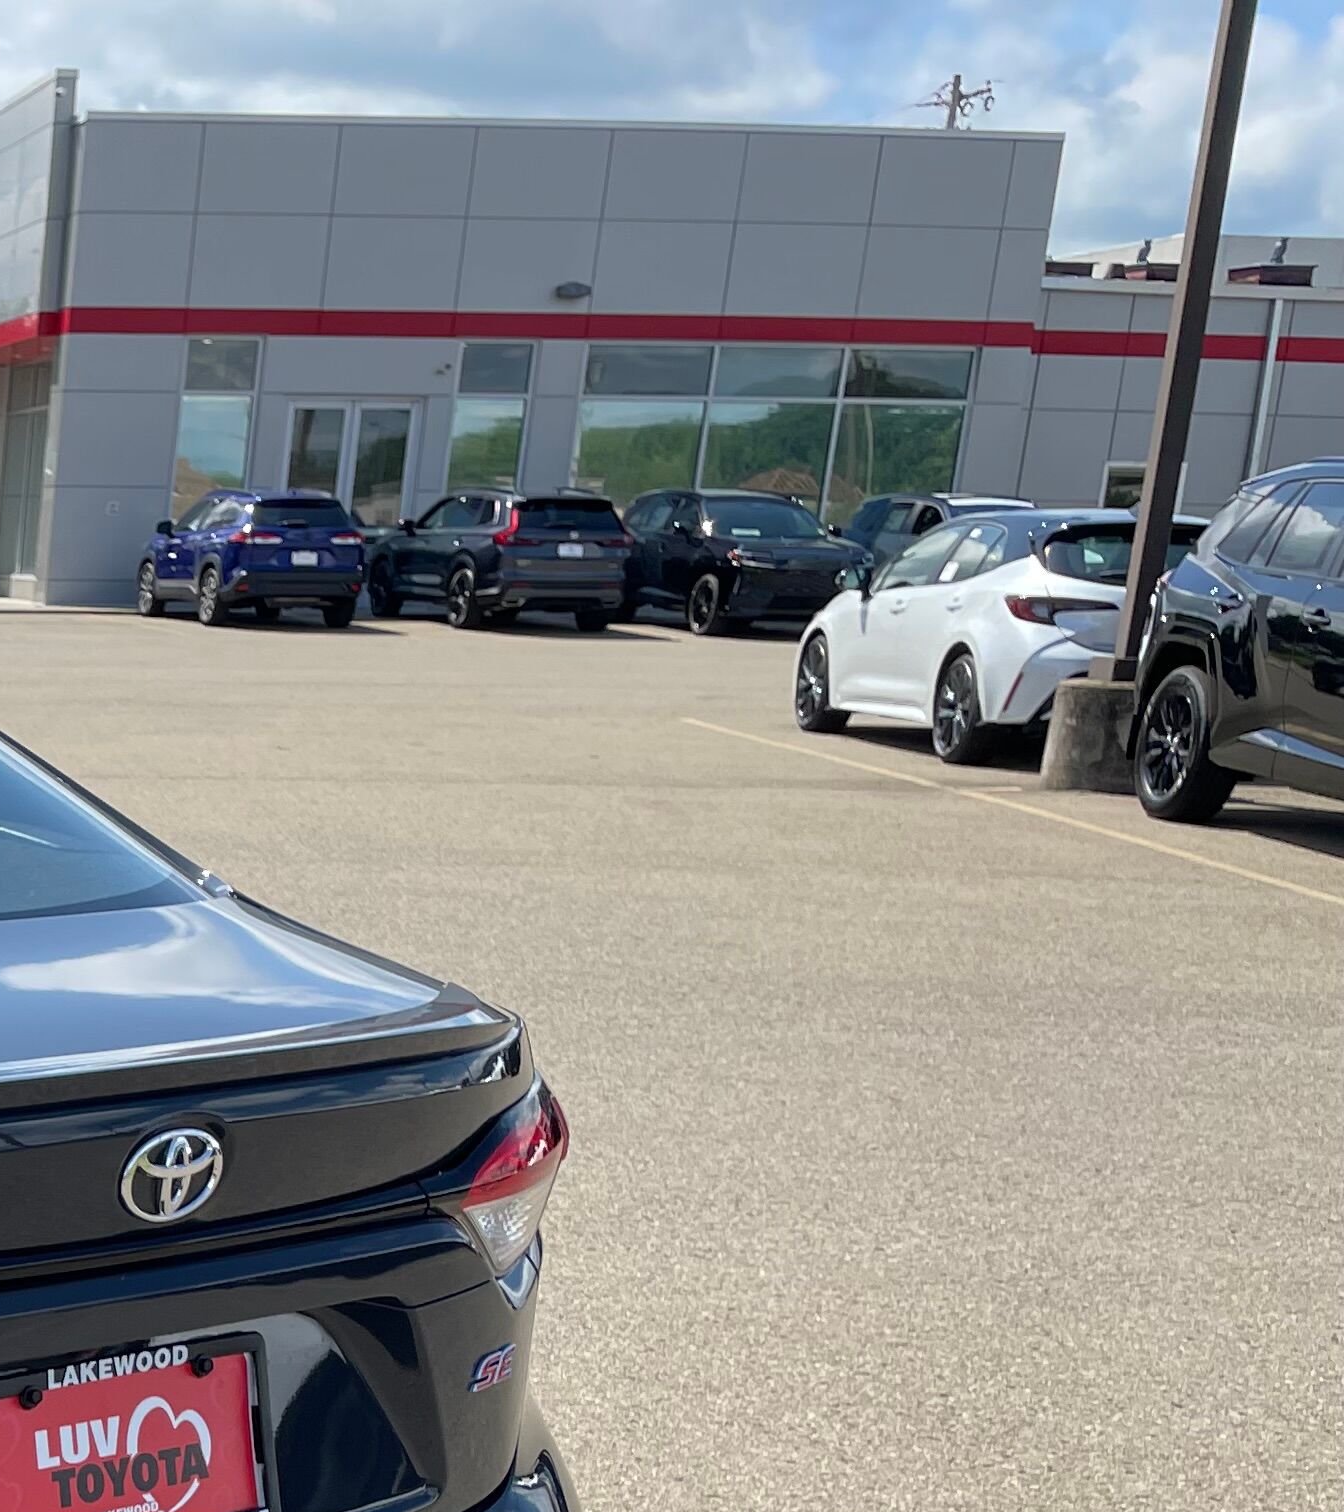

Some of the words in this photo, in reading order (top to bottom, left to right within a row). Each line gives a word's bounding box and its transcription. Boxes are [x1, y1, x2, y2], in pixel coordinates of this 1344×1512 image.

[47, 1345, 189, 1390] LAKEWOOD
[34, 1415, 120, 1470] LUV
[51, 1443, 209, 1508] TOYOTA
